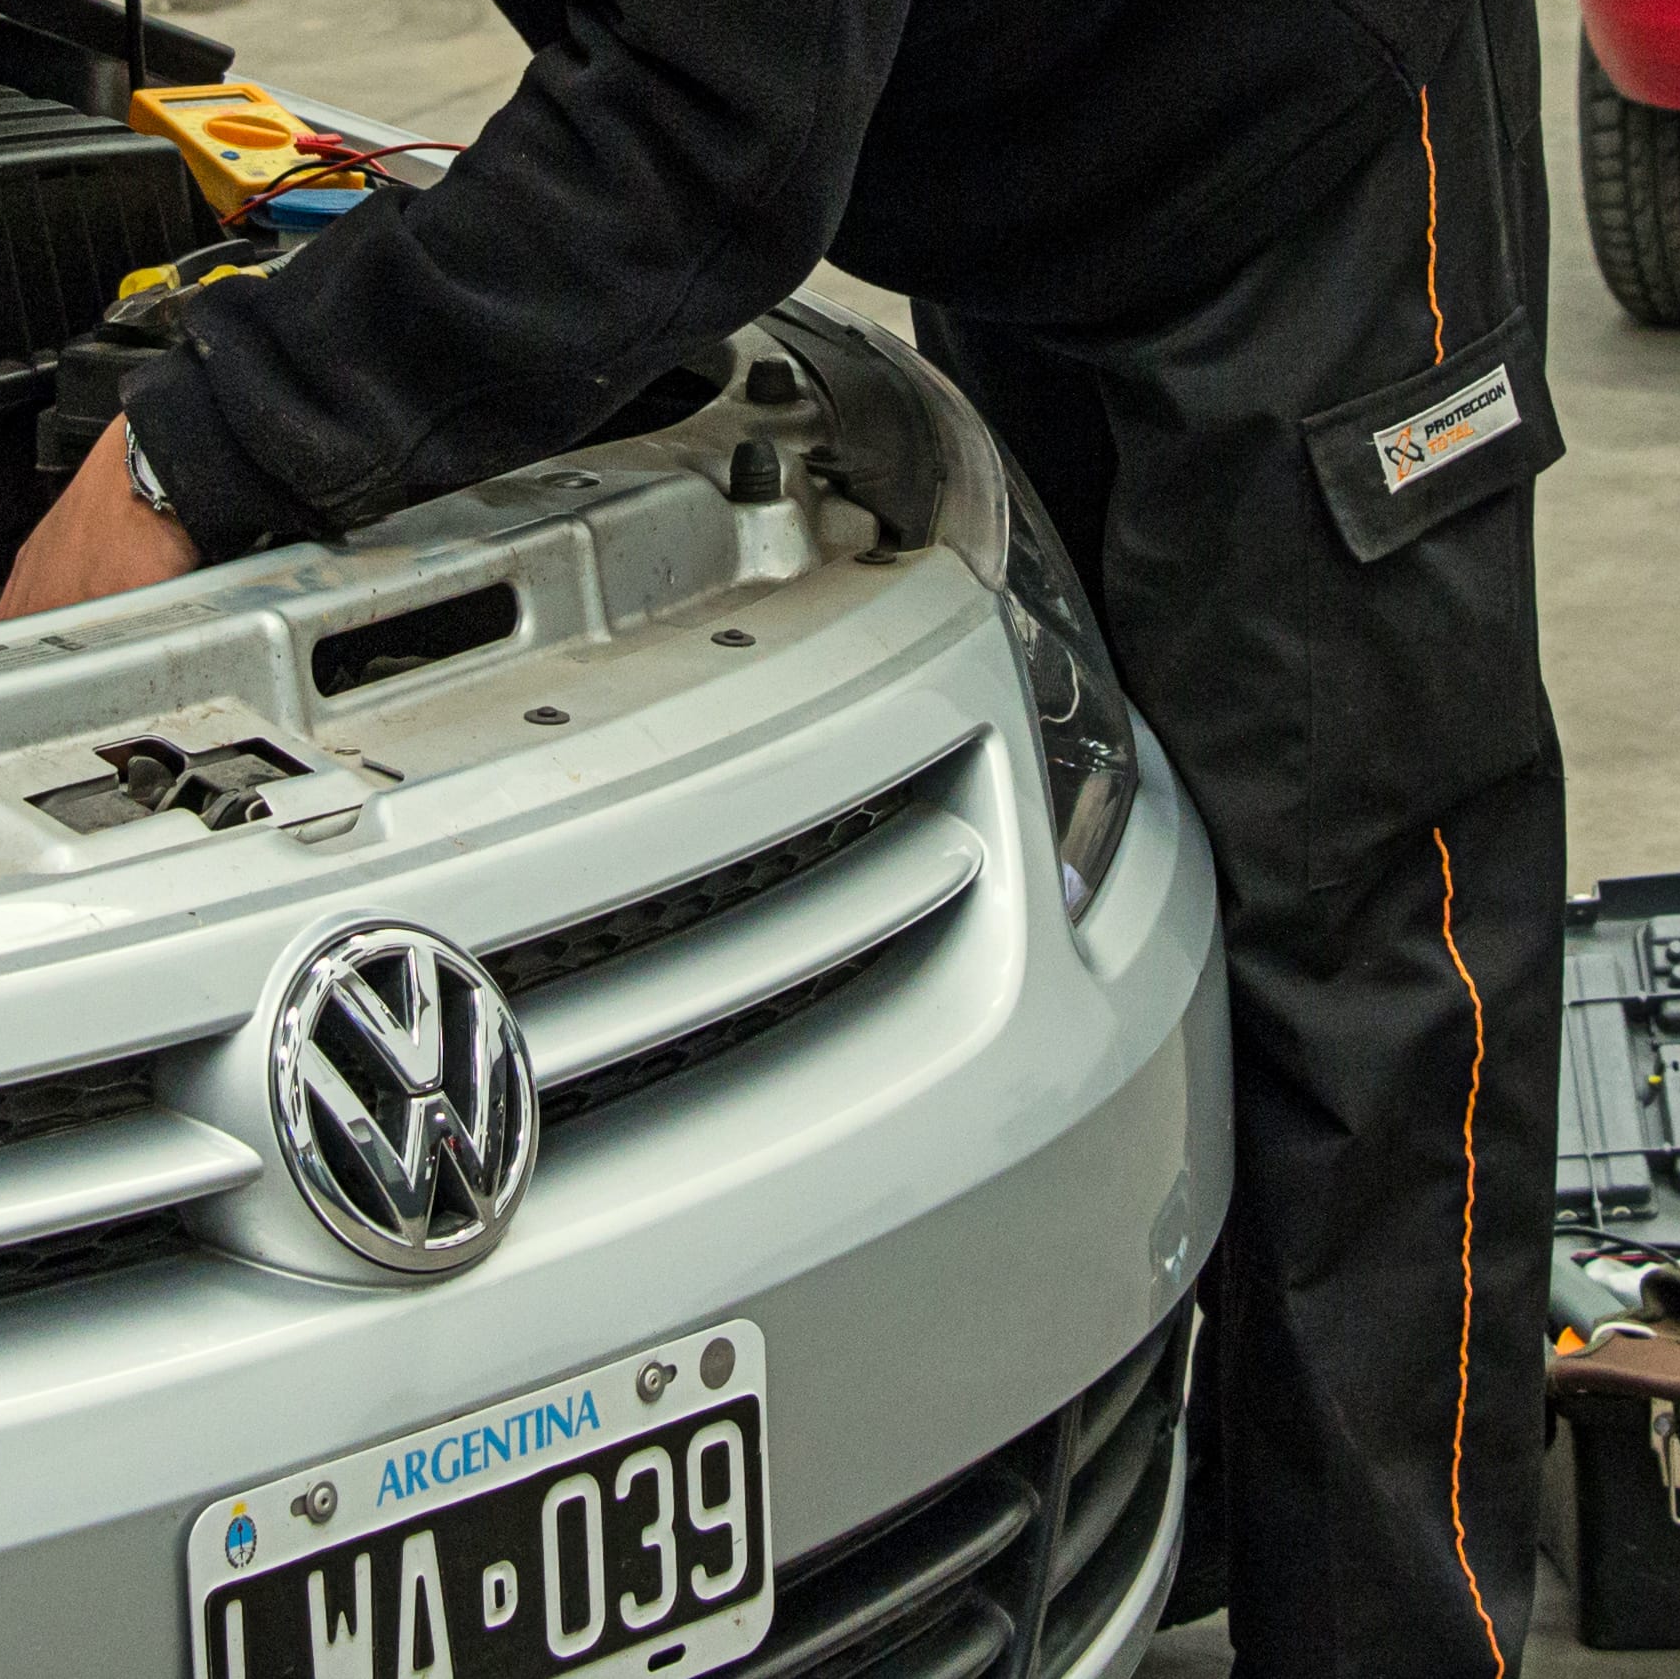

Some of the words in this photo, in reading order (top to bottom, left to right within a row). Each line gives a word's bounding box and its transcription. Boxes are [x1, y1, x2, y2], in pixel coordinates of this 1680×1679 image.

[1424, 381, 1507, 441] PROTECCION
[1427, 420, 1475, 456] TOTAL
[376, 1389, 601, 1508] ARGENTINA
[541, 1419, 749, 1659] 039
